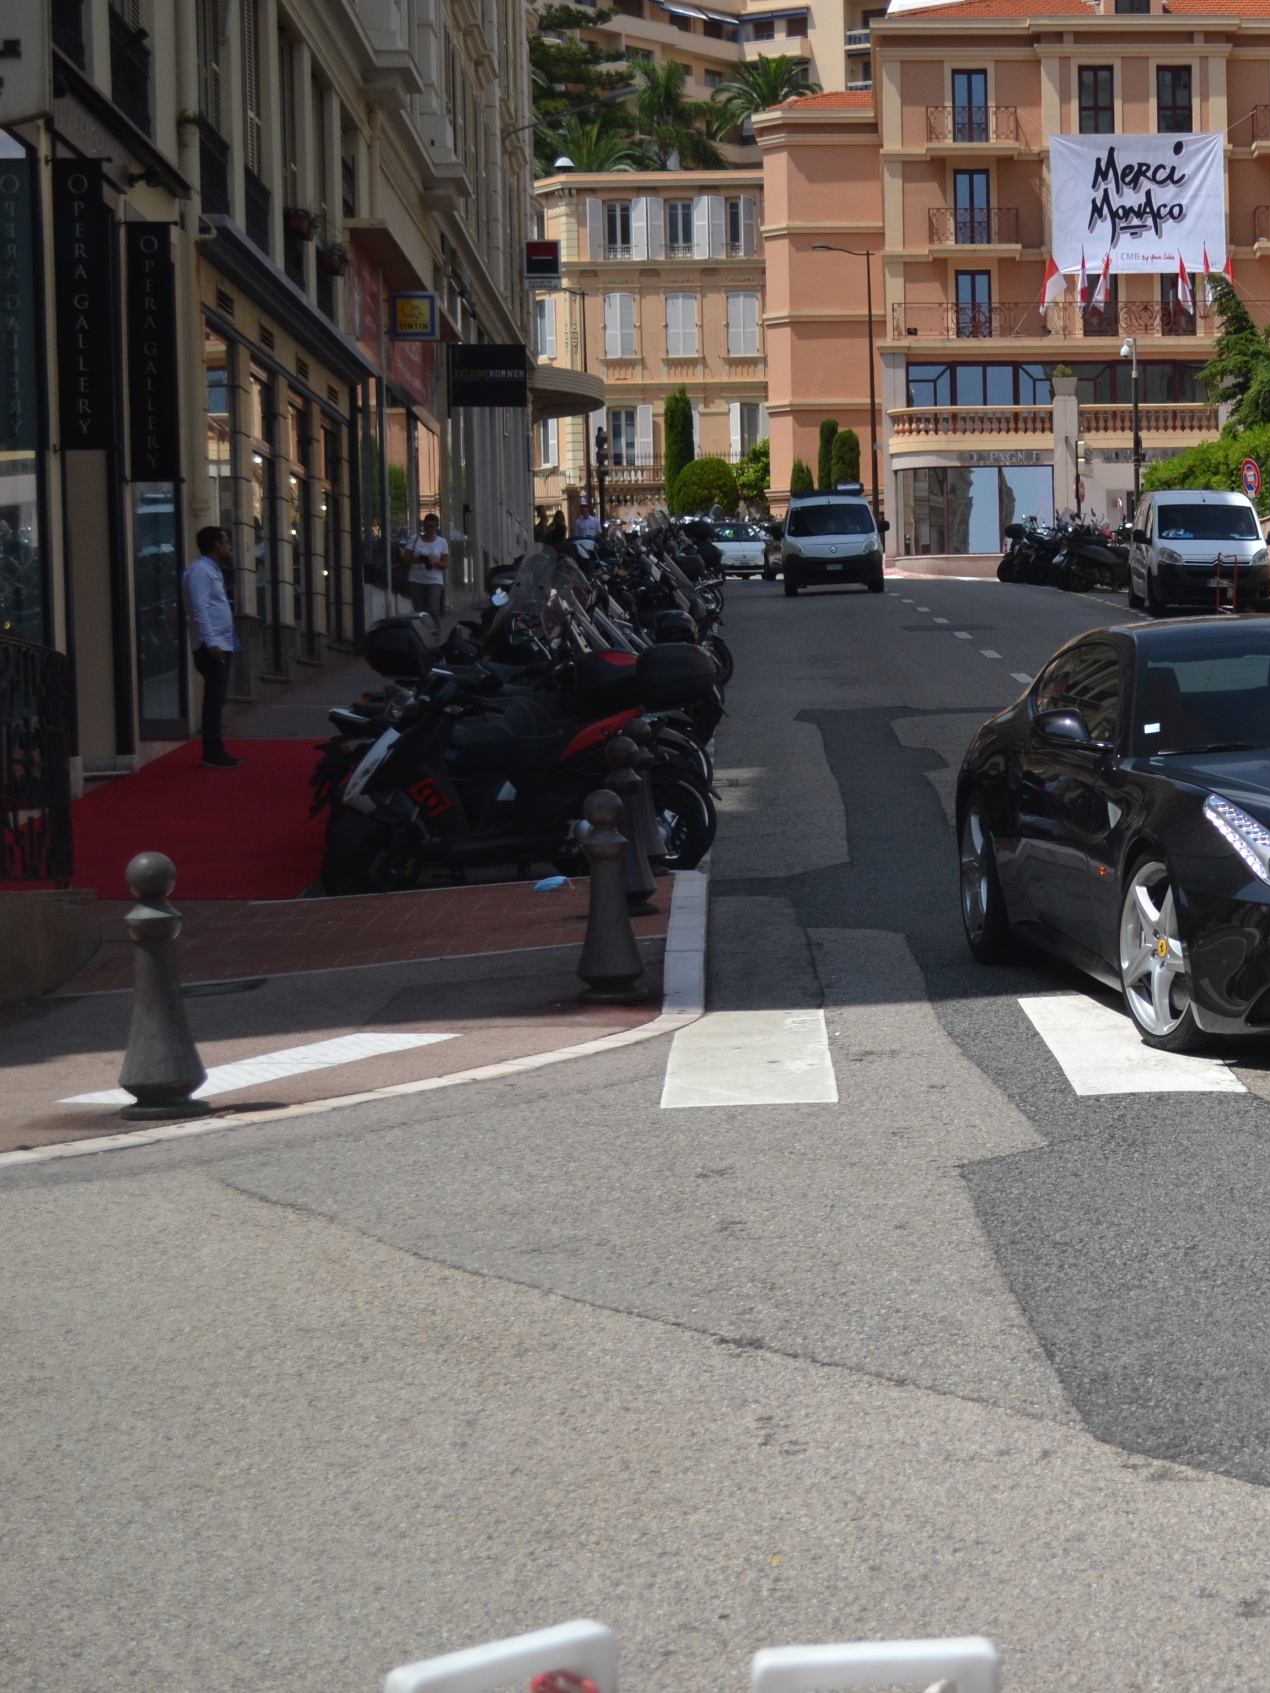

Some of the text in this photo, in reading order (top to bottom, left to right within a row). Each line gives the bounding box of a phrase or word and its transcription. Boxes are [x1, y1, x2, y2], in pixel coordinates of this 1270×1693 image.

[1120, 252, 1140, 261] CMB
[68, 173, 93, 435] OPERA GALLERY
[399, 322, 429, 331] TINTIN
[139, 235, 160, 468] OPERA GALLERY
[453, 369, 526, 378] YELLOWKORNER
